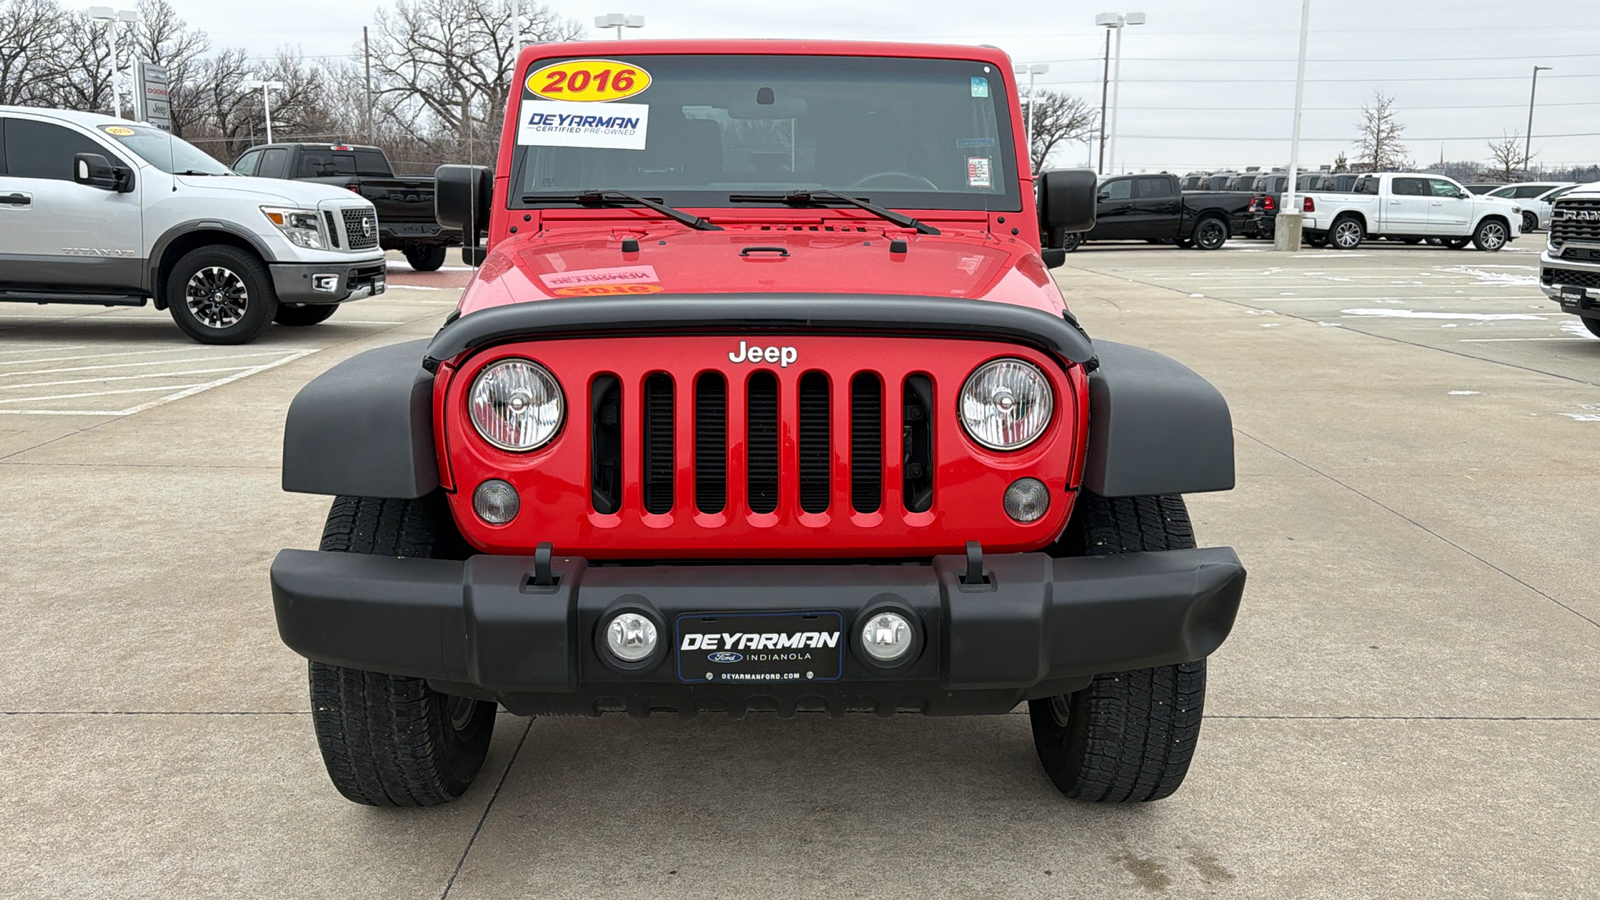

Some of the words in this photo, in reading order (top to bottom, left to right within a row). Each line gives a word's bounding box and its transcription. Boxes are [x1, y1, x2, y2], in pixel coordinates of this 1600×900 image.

[540, 69, 637, 93] 2016
[147, 87, 168, 96] DODGE
[152, 103, 167, 116] Jeep
[528, 112, 640, 129] DEYARMAN
[536, 125, 582, 134] CERTIFIED
[583, 127, 636, 136] PRE-OWNED
[62, 247, 111, 256] TITAN
[728, 340, 798, 368] Jeep
[680, 631, 841, 650] DEYARMAN
[714, 652, 736, 662] Ford
[746, 652, 812, 661] INDIANOLA
[721, 672, 800, 680] DEYARMANFORD.COM
